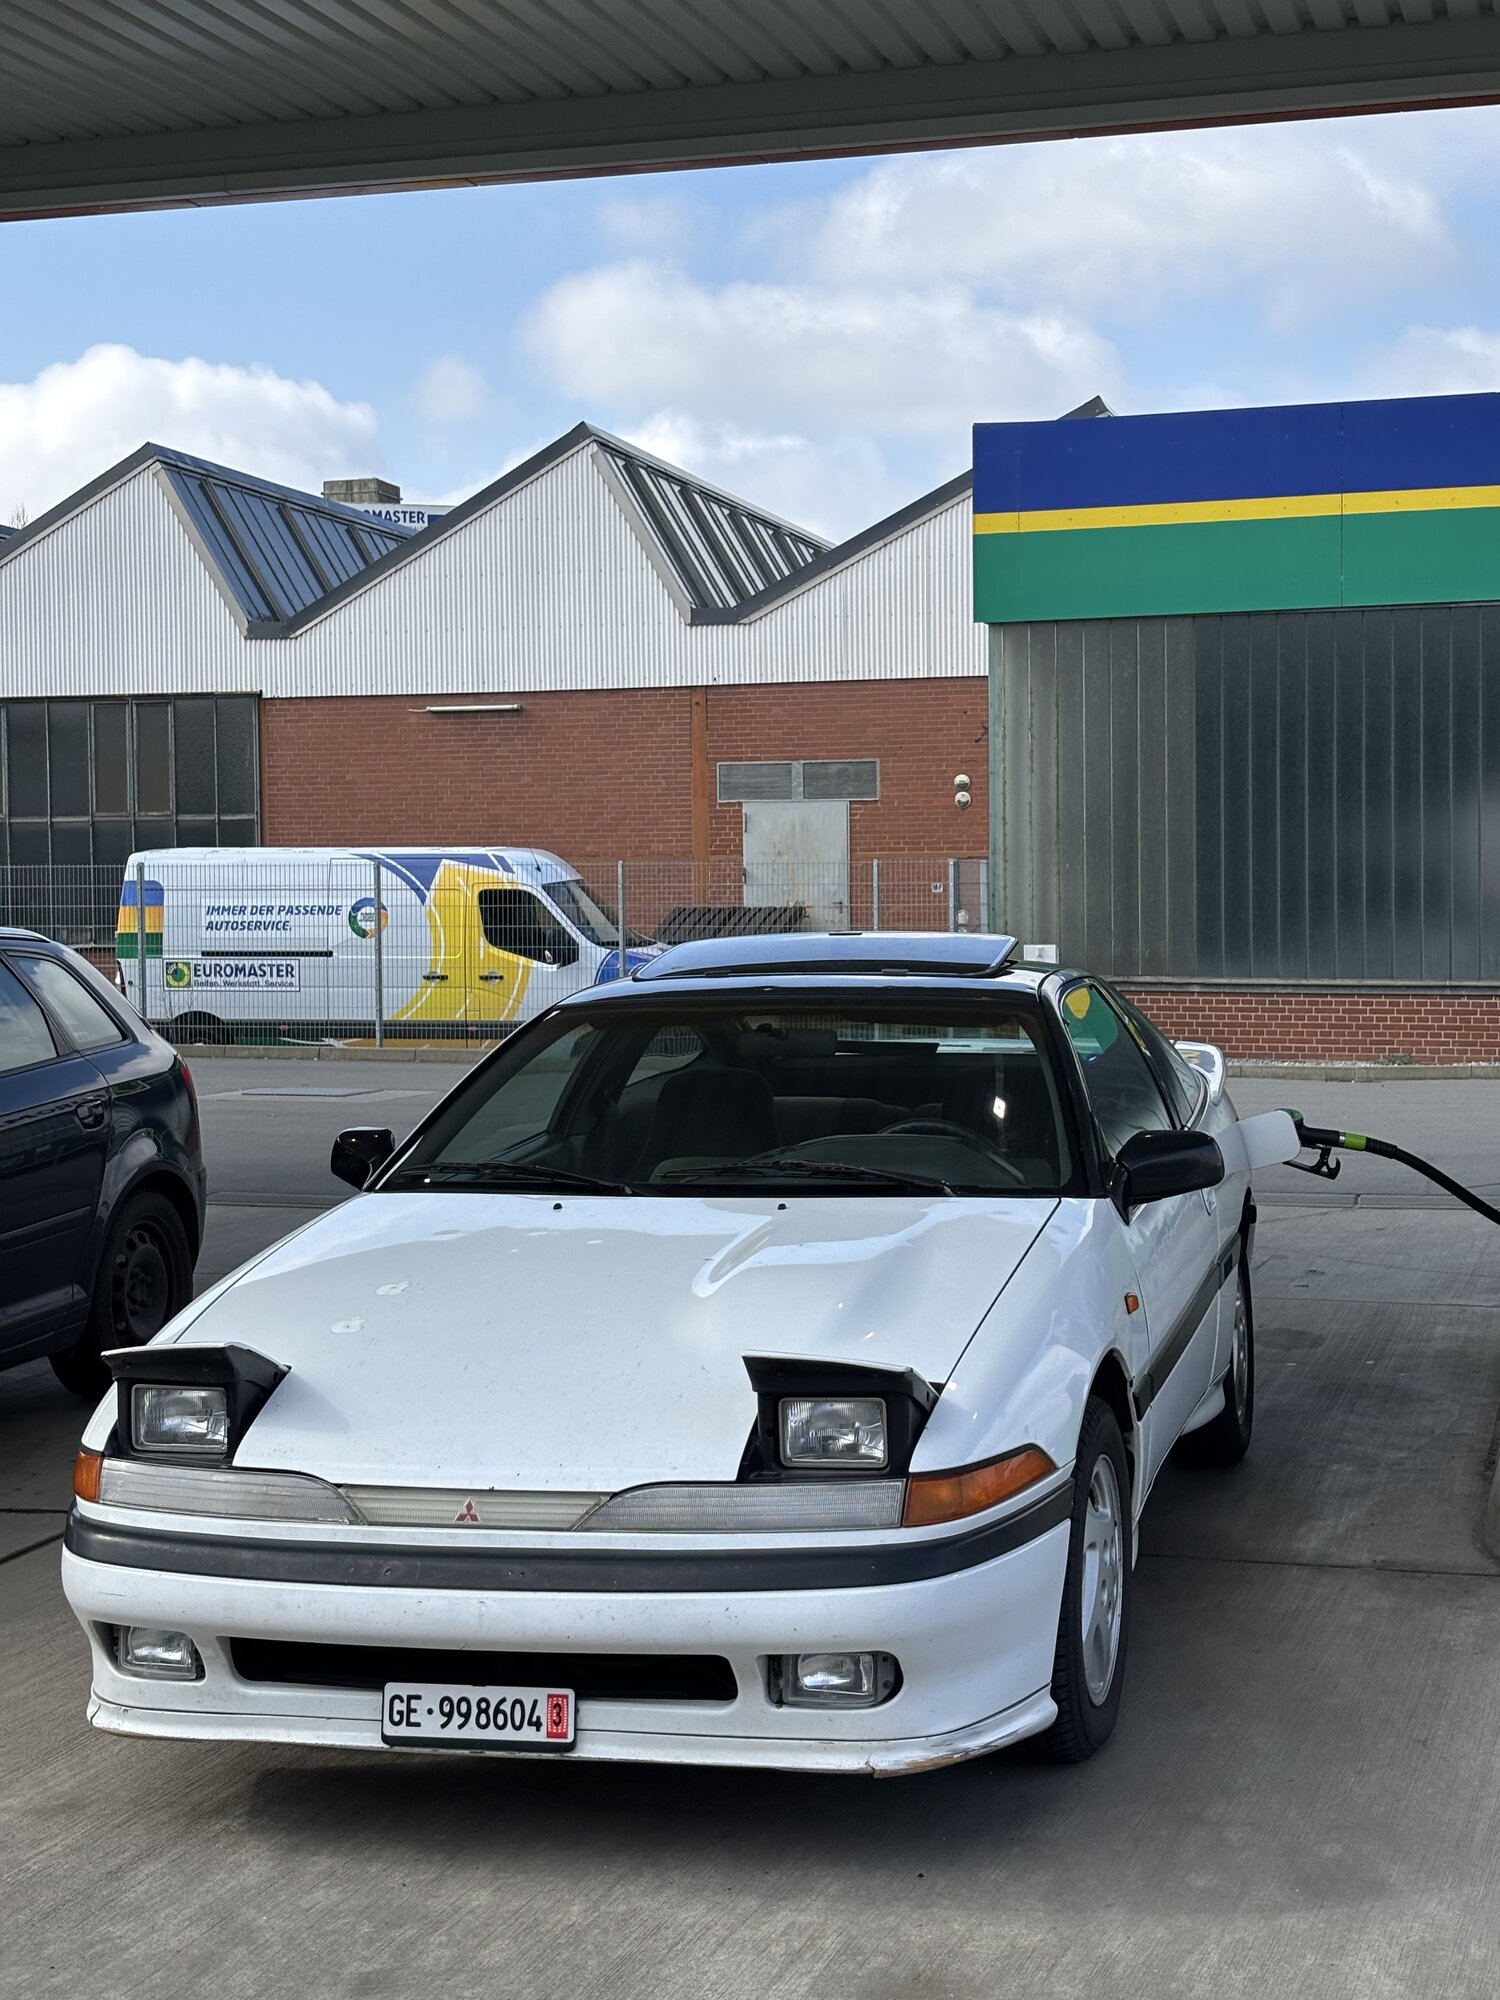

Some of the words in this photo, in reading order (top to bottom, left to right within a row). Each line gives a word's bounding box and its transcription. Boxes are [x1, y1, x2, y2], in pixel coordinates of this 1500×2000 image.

[206, 905, 247, 916] IMMER
[250, 905, 274, 916] DER
[277, 905, 342, 916] PASSENDE
[205, 920, 292, 931] AUTOSERVICE.
[193, 963, 295, 978] EUROMASTER
[553, 1702, 562, 1727] 3
